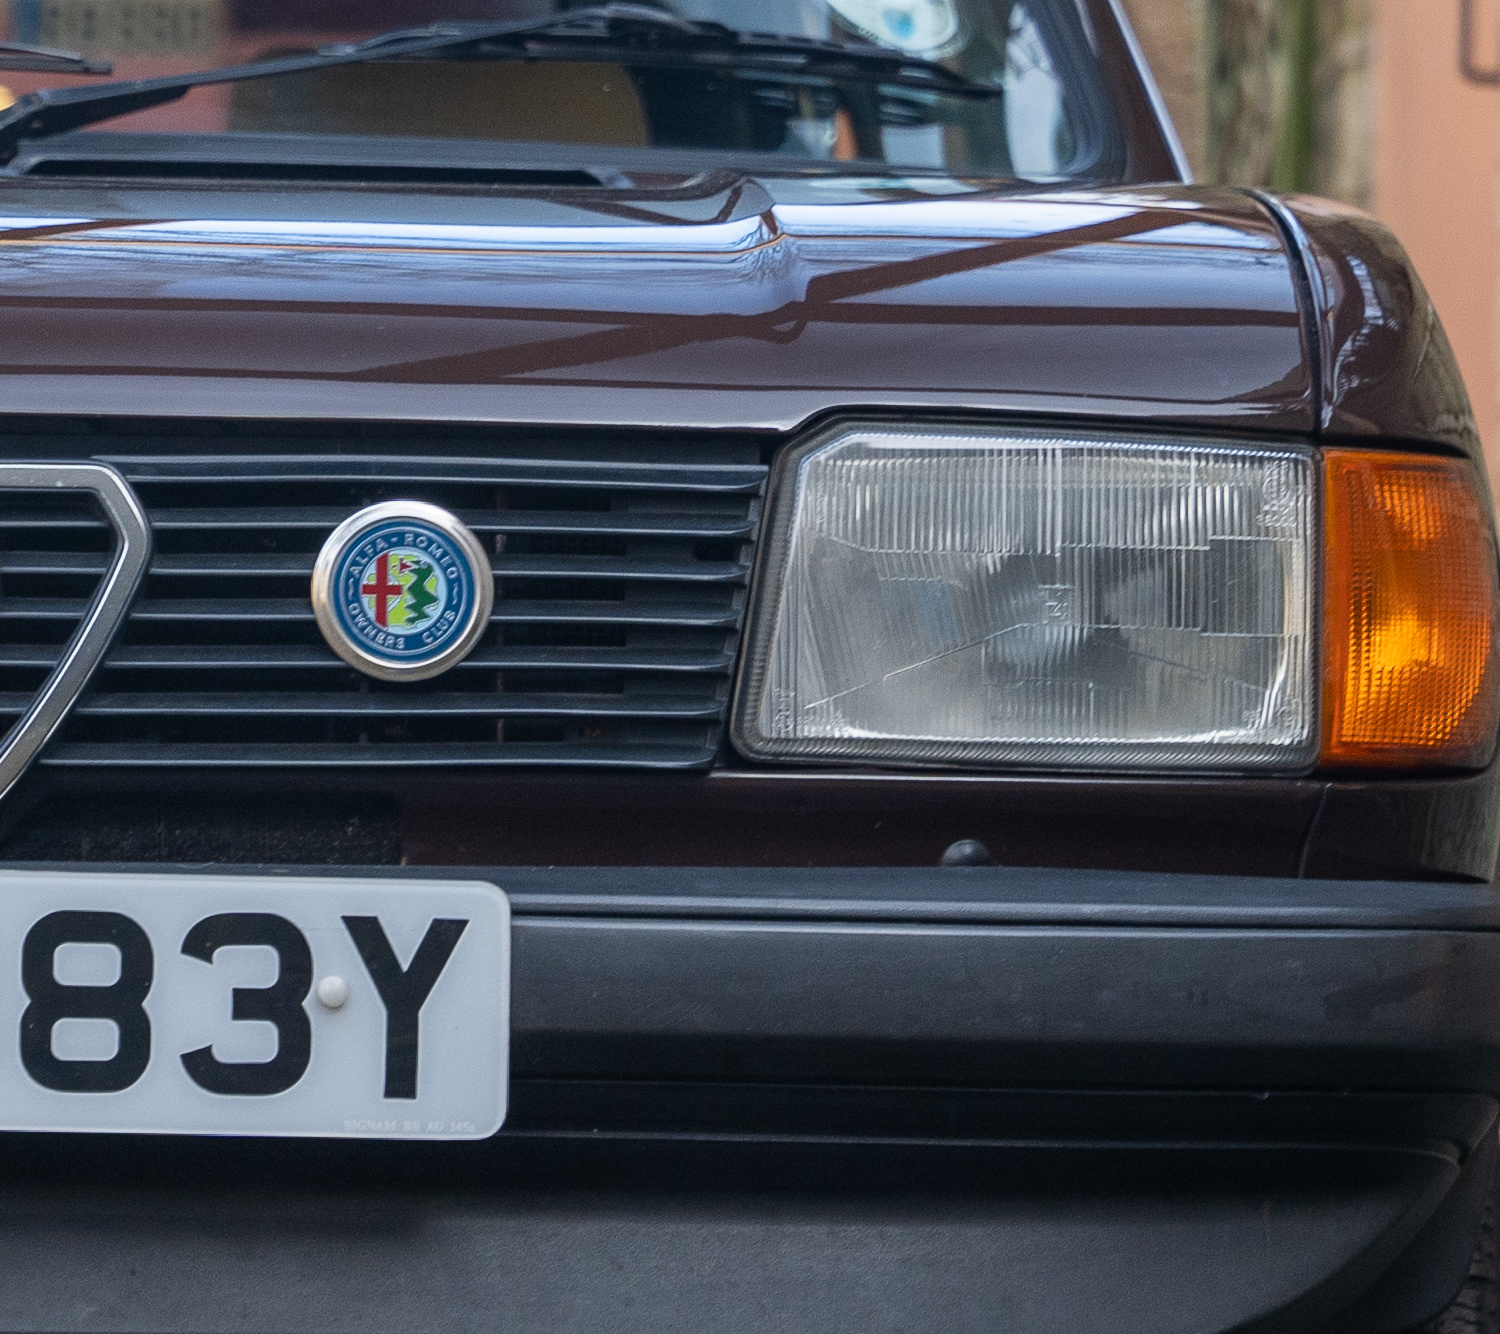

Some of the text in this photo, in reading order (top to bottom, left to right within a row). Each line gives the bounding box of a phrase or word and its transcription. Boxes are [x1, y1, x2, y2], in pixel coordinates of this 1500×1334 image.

[348, 602, 456, 650] OWNERS CLUB
[403, 1120, 420, 1132] BS
[426, 1121, 444, 1132] AU
